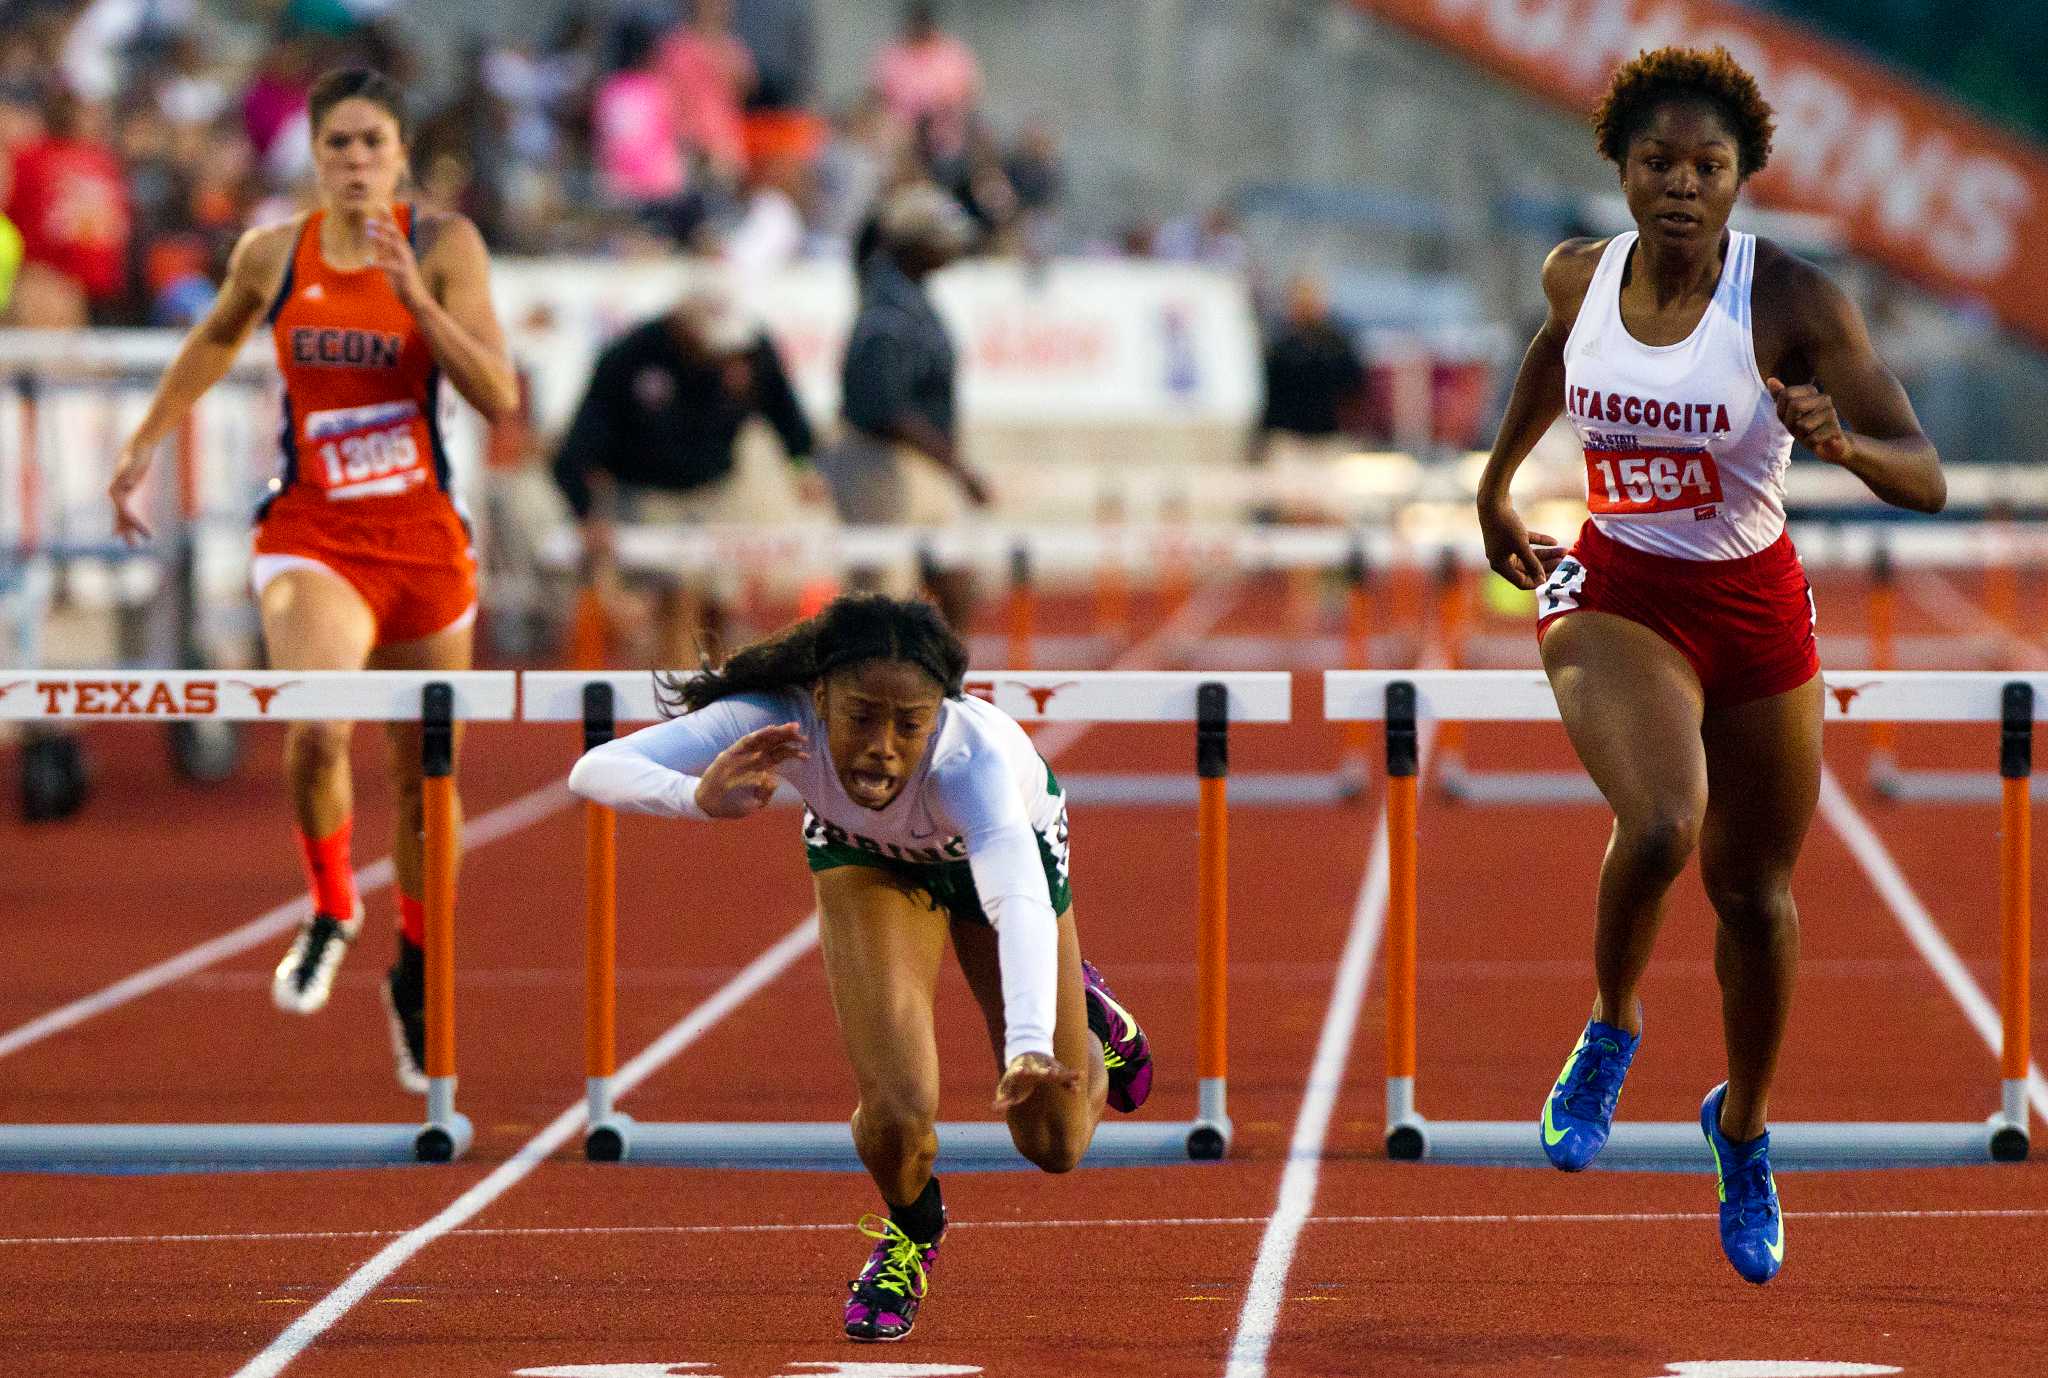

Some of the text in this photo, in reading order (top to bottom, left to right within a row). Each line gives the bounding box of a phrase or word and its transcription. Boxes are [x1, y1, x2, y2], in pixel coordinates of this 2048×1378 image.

[293, 330, 400, 367] ECON
[1596, 457, 1711, 503] 1564
[36, 681, 218, 714] TEXAS
